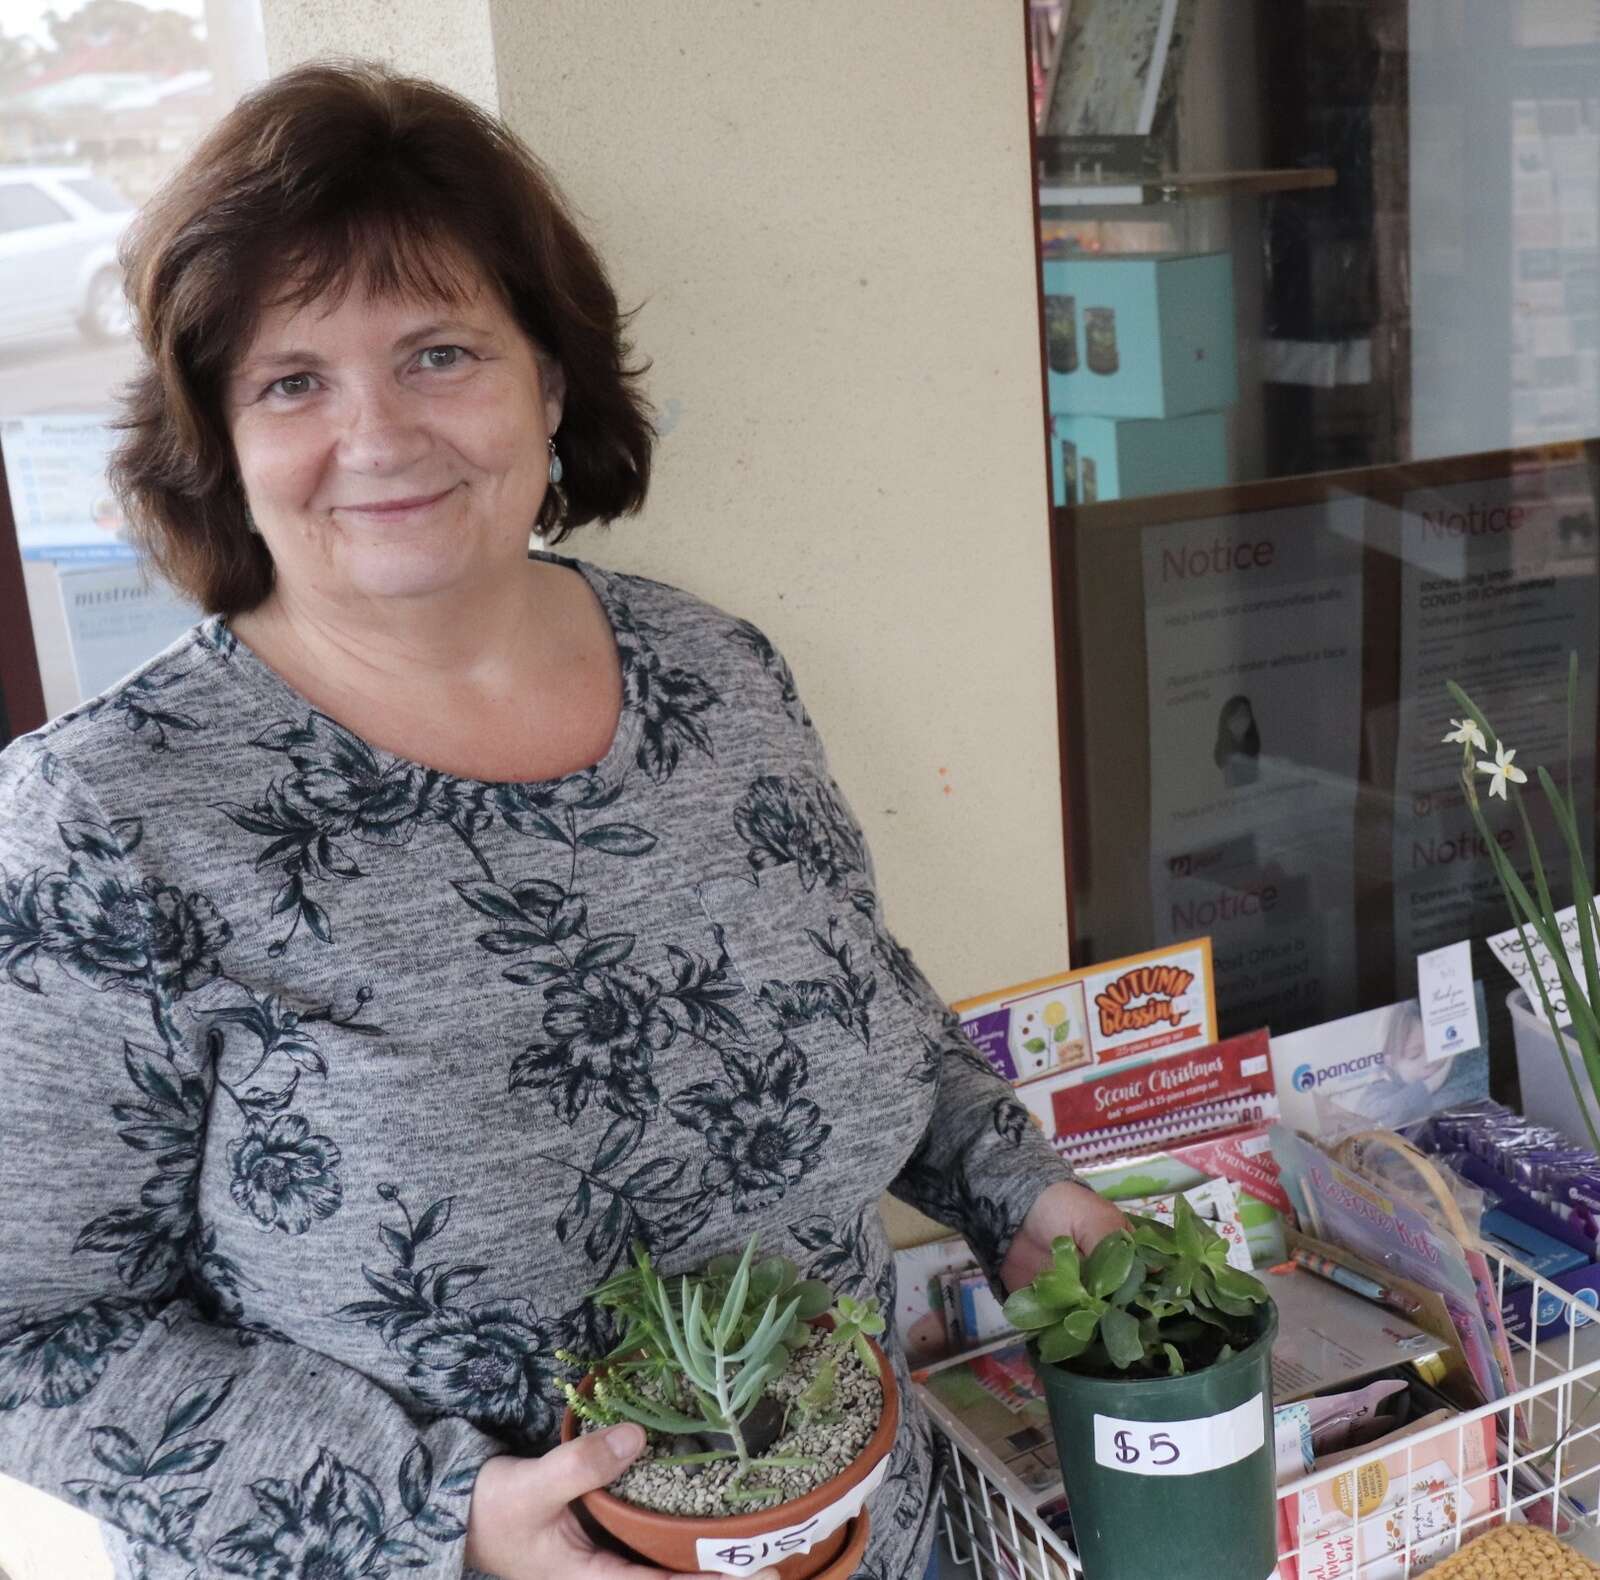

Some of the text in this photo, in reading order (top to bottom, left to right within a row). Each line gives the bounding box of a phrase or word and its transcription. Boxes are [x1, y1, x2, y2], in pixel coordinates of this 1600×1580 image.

[1421, 502, 1525, 541] Notice
[1162, 536, 1275, 583] Notice
[74, 587, 149, 607] mistra
[1411, 829, 1516, 870] Notice
[1170, 884, 1280, 935] Notice
[1094, 965, 1195, 1011] AUTUMN
[1093, 1078, 1144, 1112] Scenic
[1147, 1055, 1225, 1093] Christmas
[1315, 1050, 1386, 1087] pancare
[1113, 1429, 1182, 1466] $5
[715, 1518, 819, 1567] $15
